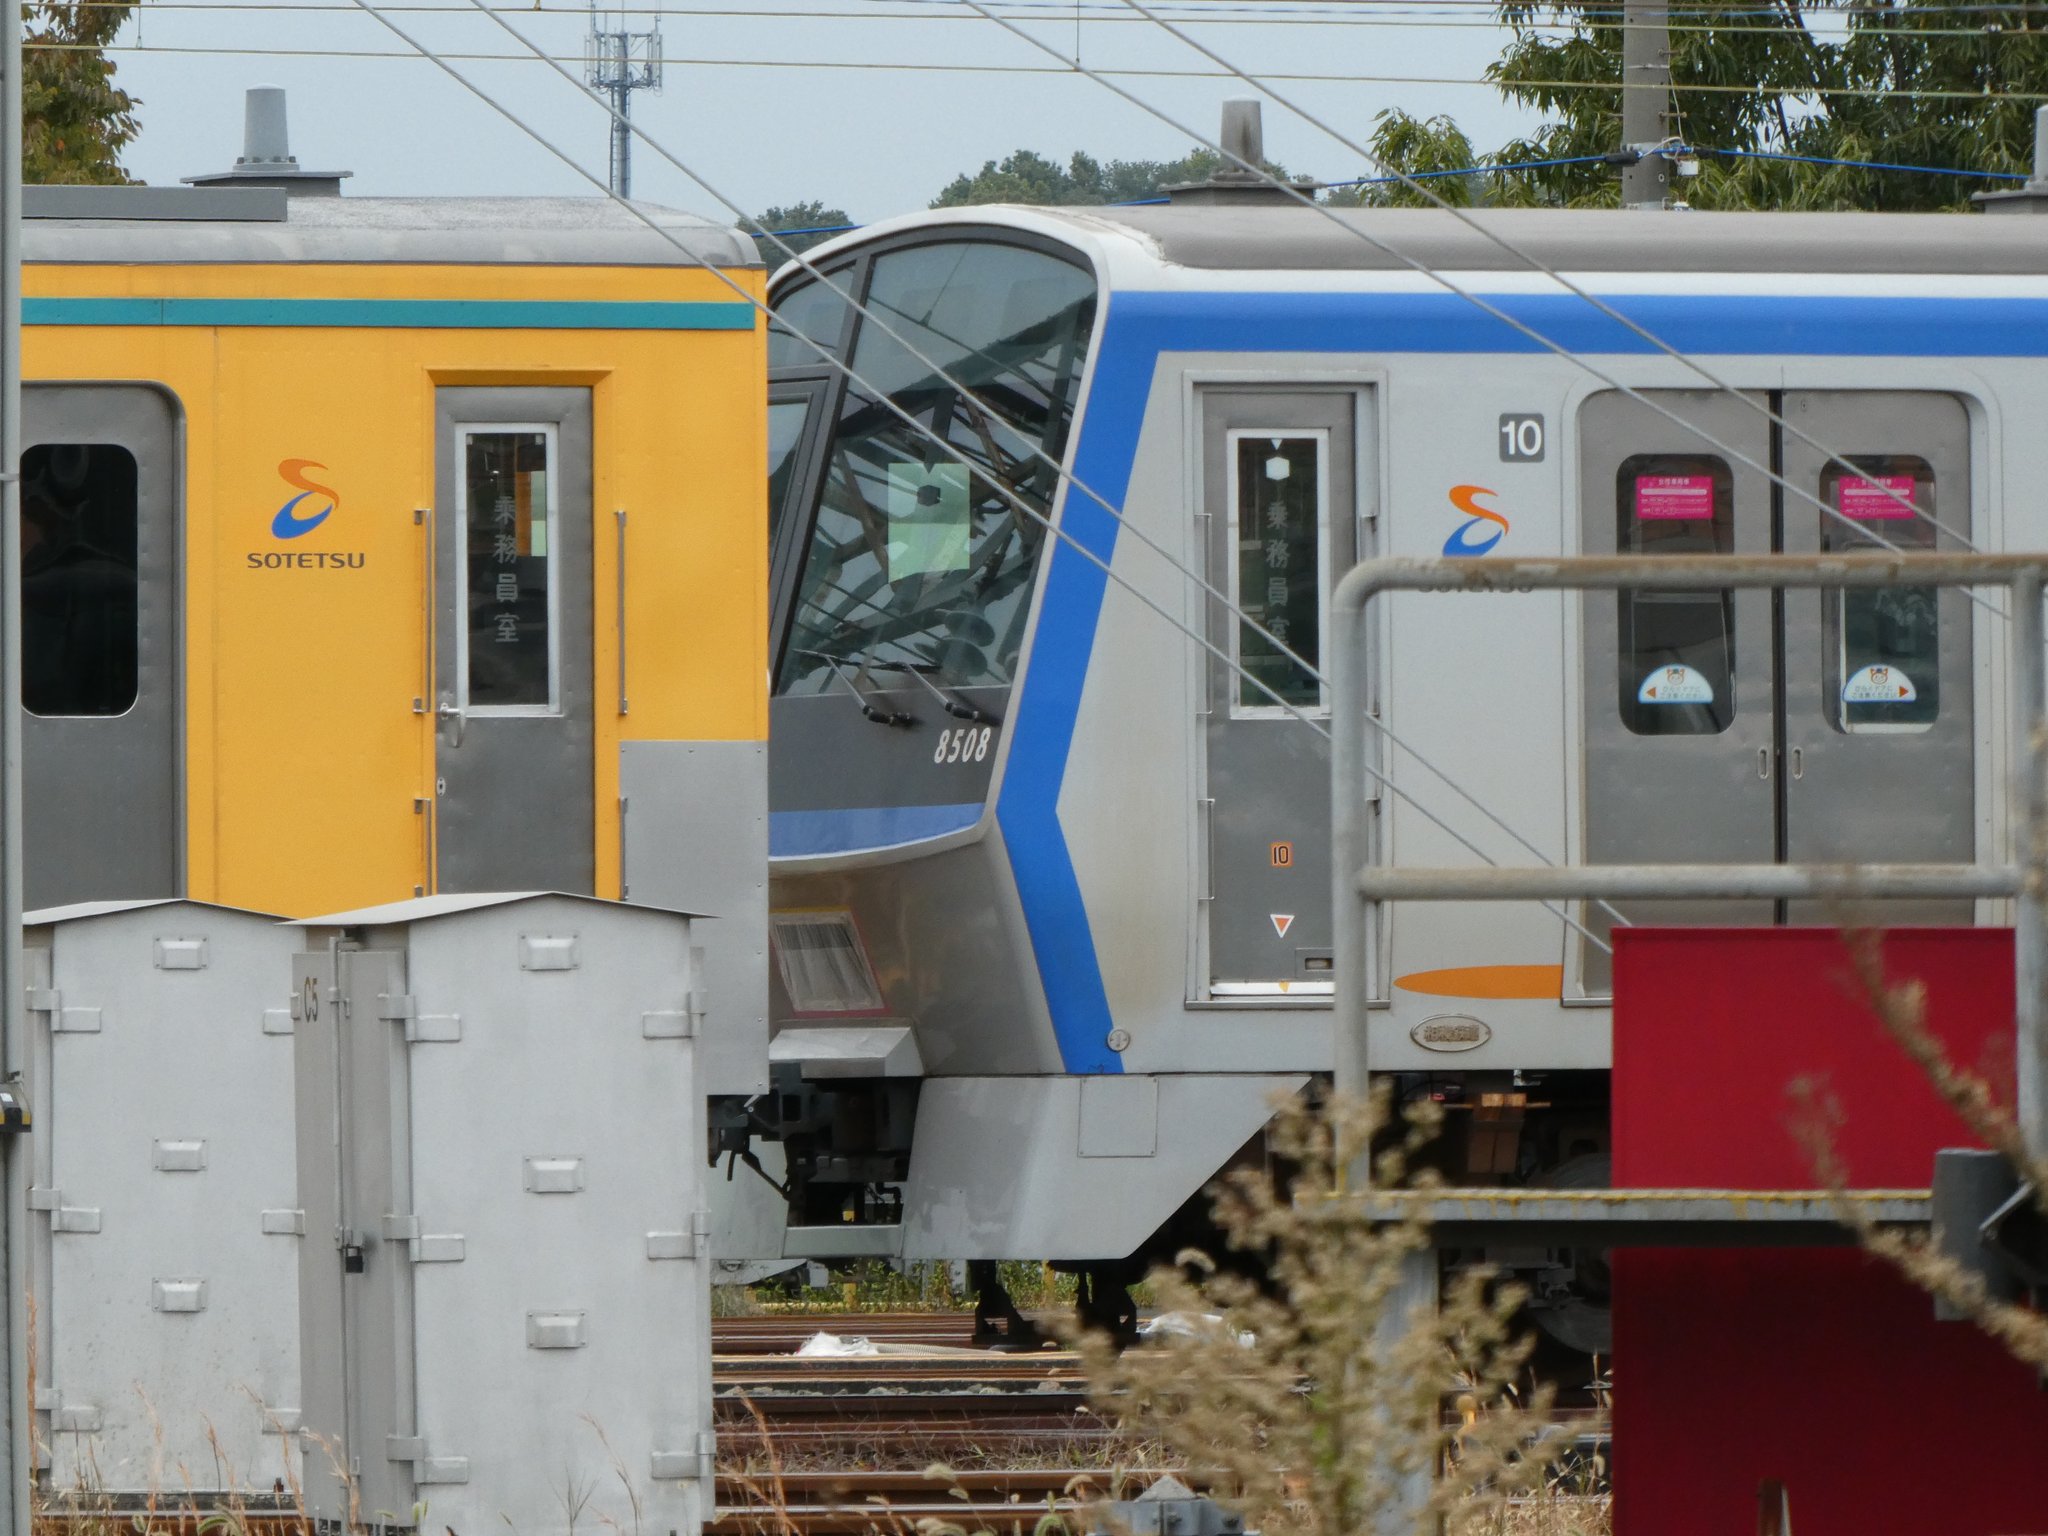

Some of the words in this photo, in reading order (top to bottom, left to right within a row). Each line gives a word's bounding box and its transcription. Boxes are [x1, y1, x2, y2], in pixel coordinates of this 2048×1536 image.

[1501, 420, 1542, 456] 10
[247, 552, 365, 569] SOTETSU
[493, 495, 520, 642] 乗務員室
[934, 727, 991, 764] 8508
[1273, 845, 1289, 865] 10
[303, 976, 319, 1023] C5
